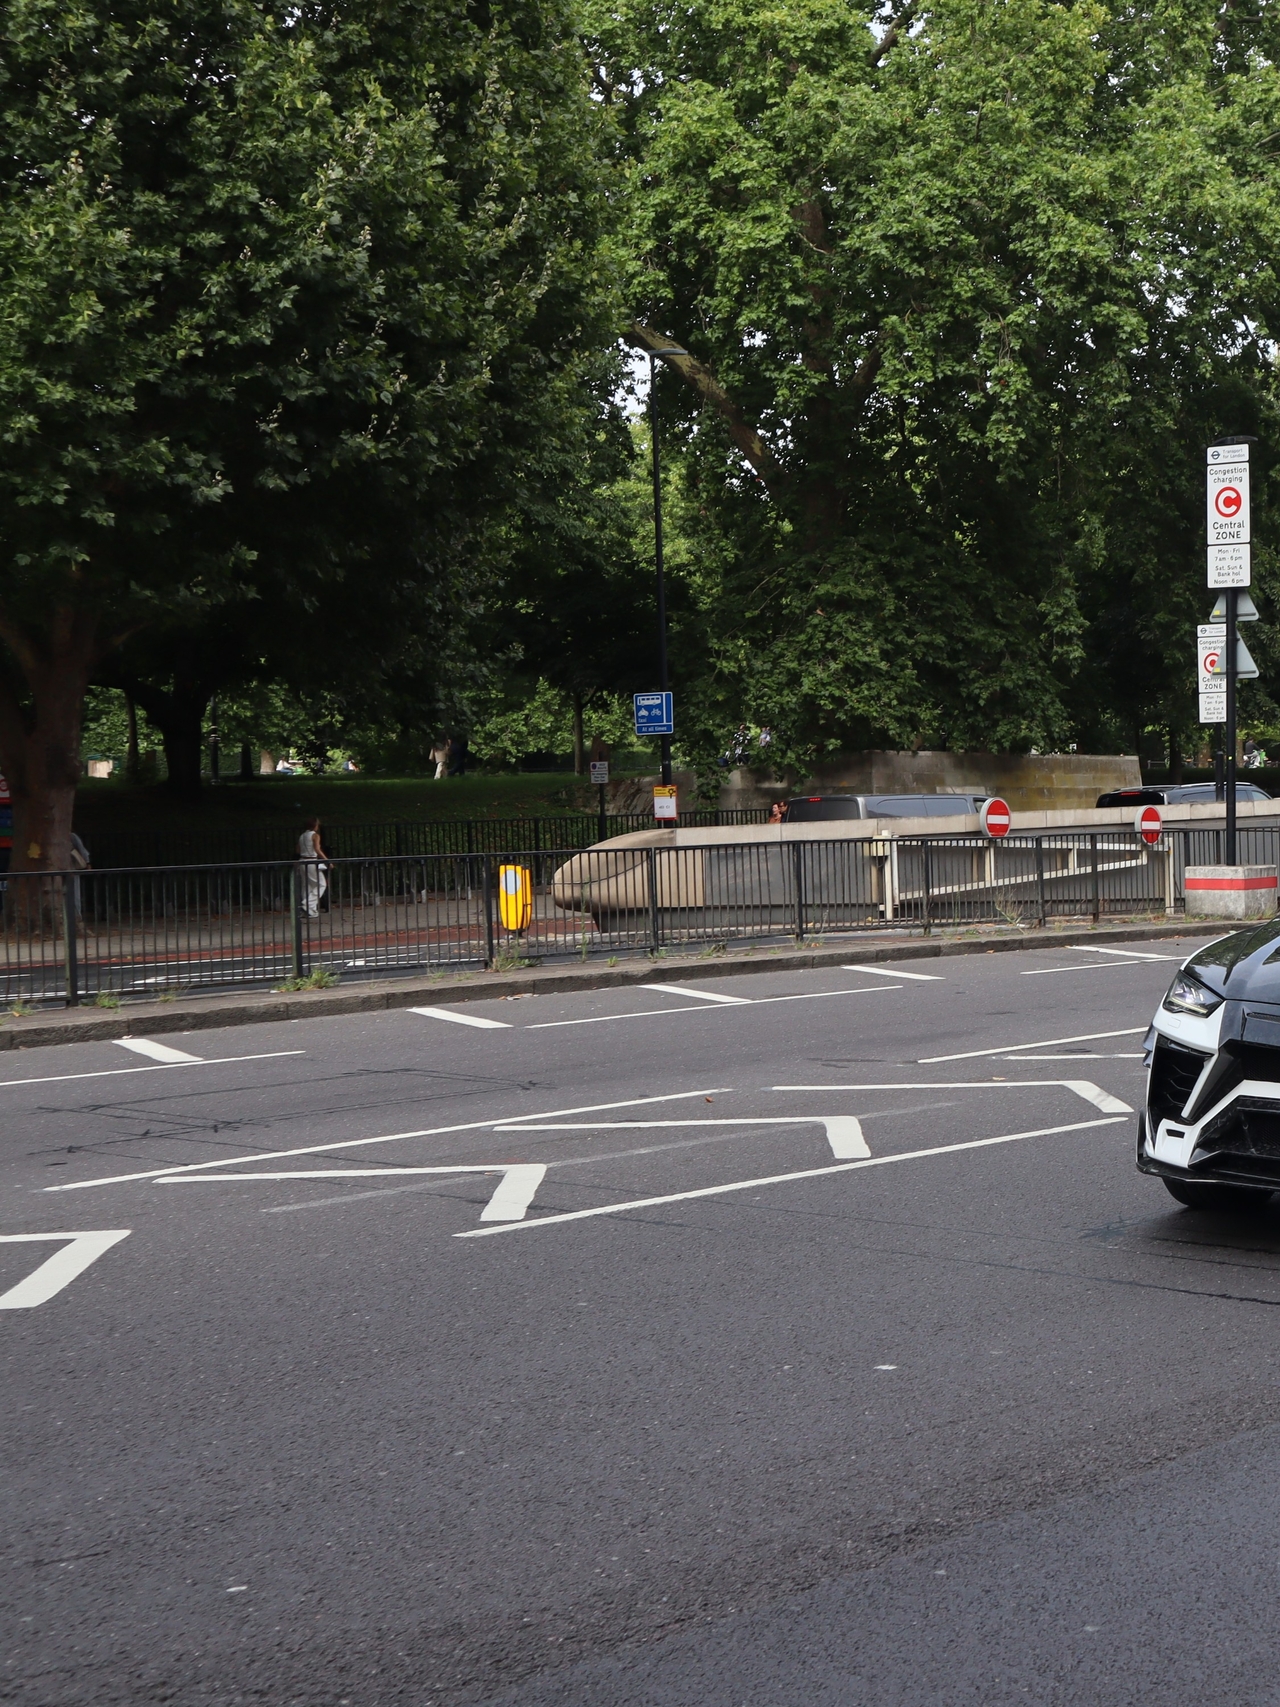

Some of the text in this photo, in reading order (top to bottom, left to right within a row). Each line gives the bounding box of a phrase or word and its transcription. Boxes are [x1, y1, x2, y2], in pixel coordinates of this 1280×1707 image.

[1209, 467, 1247, 476] Congestion
[1213, 476, 1243, 484] charging
[1212, 520, 1245, 530] Central
[1216, 531, 1241, 540] ZONE
